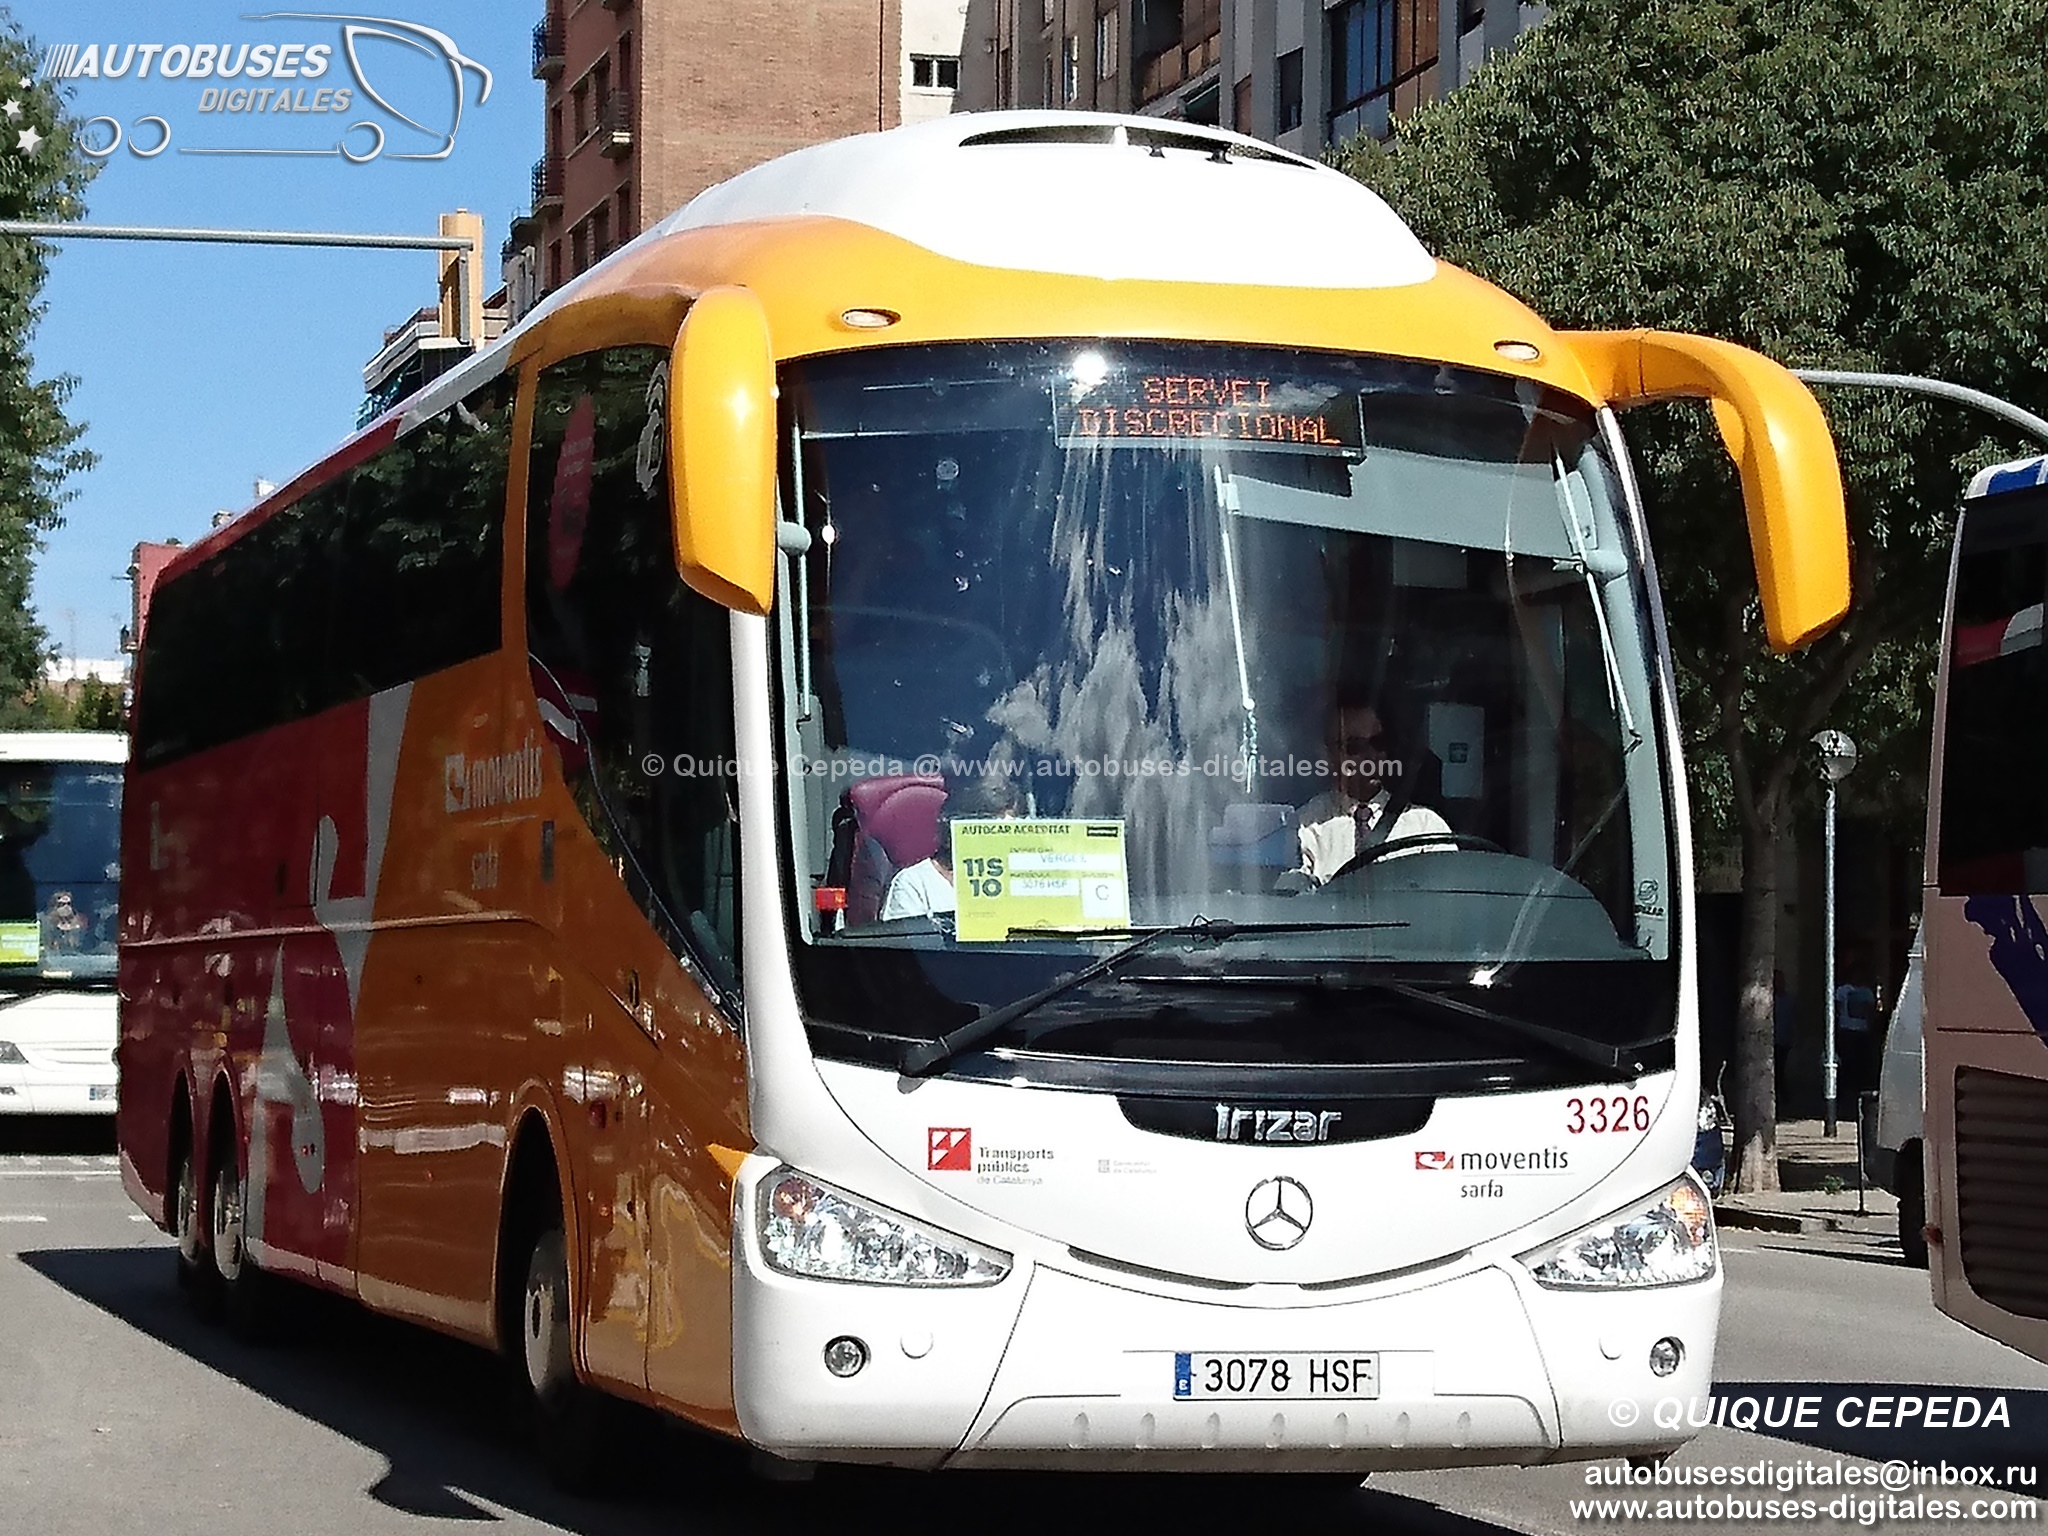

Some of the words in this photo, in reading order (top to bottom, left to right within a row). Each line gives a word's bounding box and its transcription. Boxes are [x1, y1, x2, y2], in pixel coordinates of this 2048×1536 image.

[1143, 377, 1271, 408] SERVEI
[1078, 407, 1341, 445] DISCRECIONAL
[961, 824, 1012, 835] AUTOCAR
[963, 857, 1004, 877] 11S
[969, 878, 1002, 898] 10
[1095, 884, 1110, 901] C
[1566, 1095, 1650, 1134] 3326
[979, 1146, 1055, 1161] Transports
[1461, 1146, 1569, 1171] moventis
[1461, 1179, 1504, 1198] sarfa
[1204, 1358, 1290, 1393] 3078
[1309, 1358, 1372, 1393] HSF
